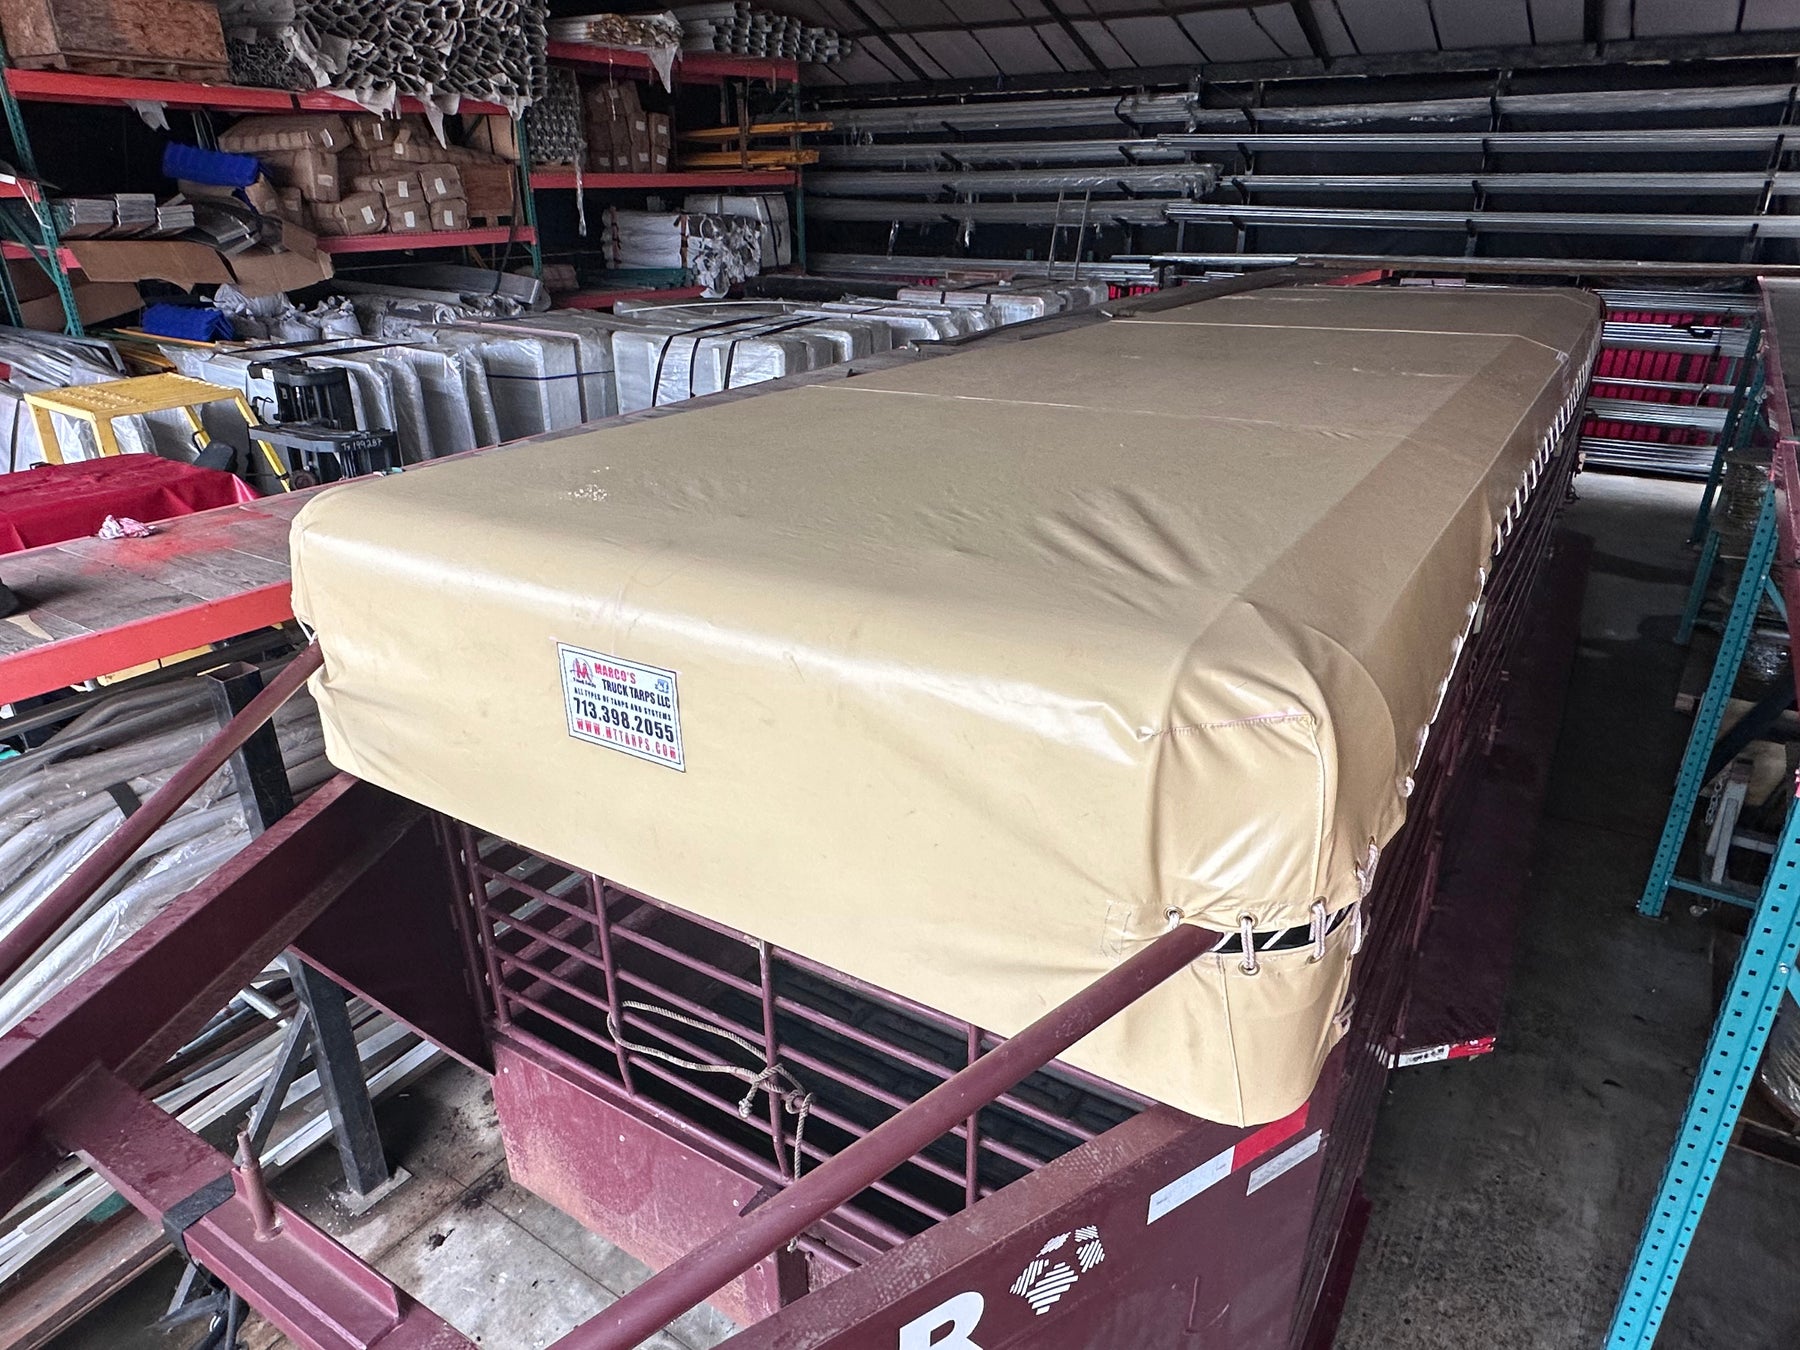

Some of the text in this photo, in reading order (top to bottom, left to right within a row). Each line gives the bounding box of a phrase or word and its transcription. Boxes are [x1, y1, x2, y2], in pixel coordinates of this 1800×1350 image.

[594, 663, 636, 684] MARCO'S
[574, 687, 672, 721] ALL TYPES OF TARPS AND SYSTEMS
[602, 678, 628, 698] TRUCK
[630, 686, 655, 704] TARPS
[656, 696, 671, 709] LLC
[573, 697, 673, 743] 713.398.2055
[577, 717, 677, 760] WWW.MTTARPS.COM
